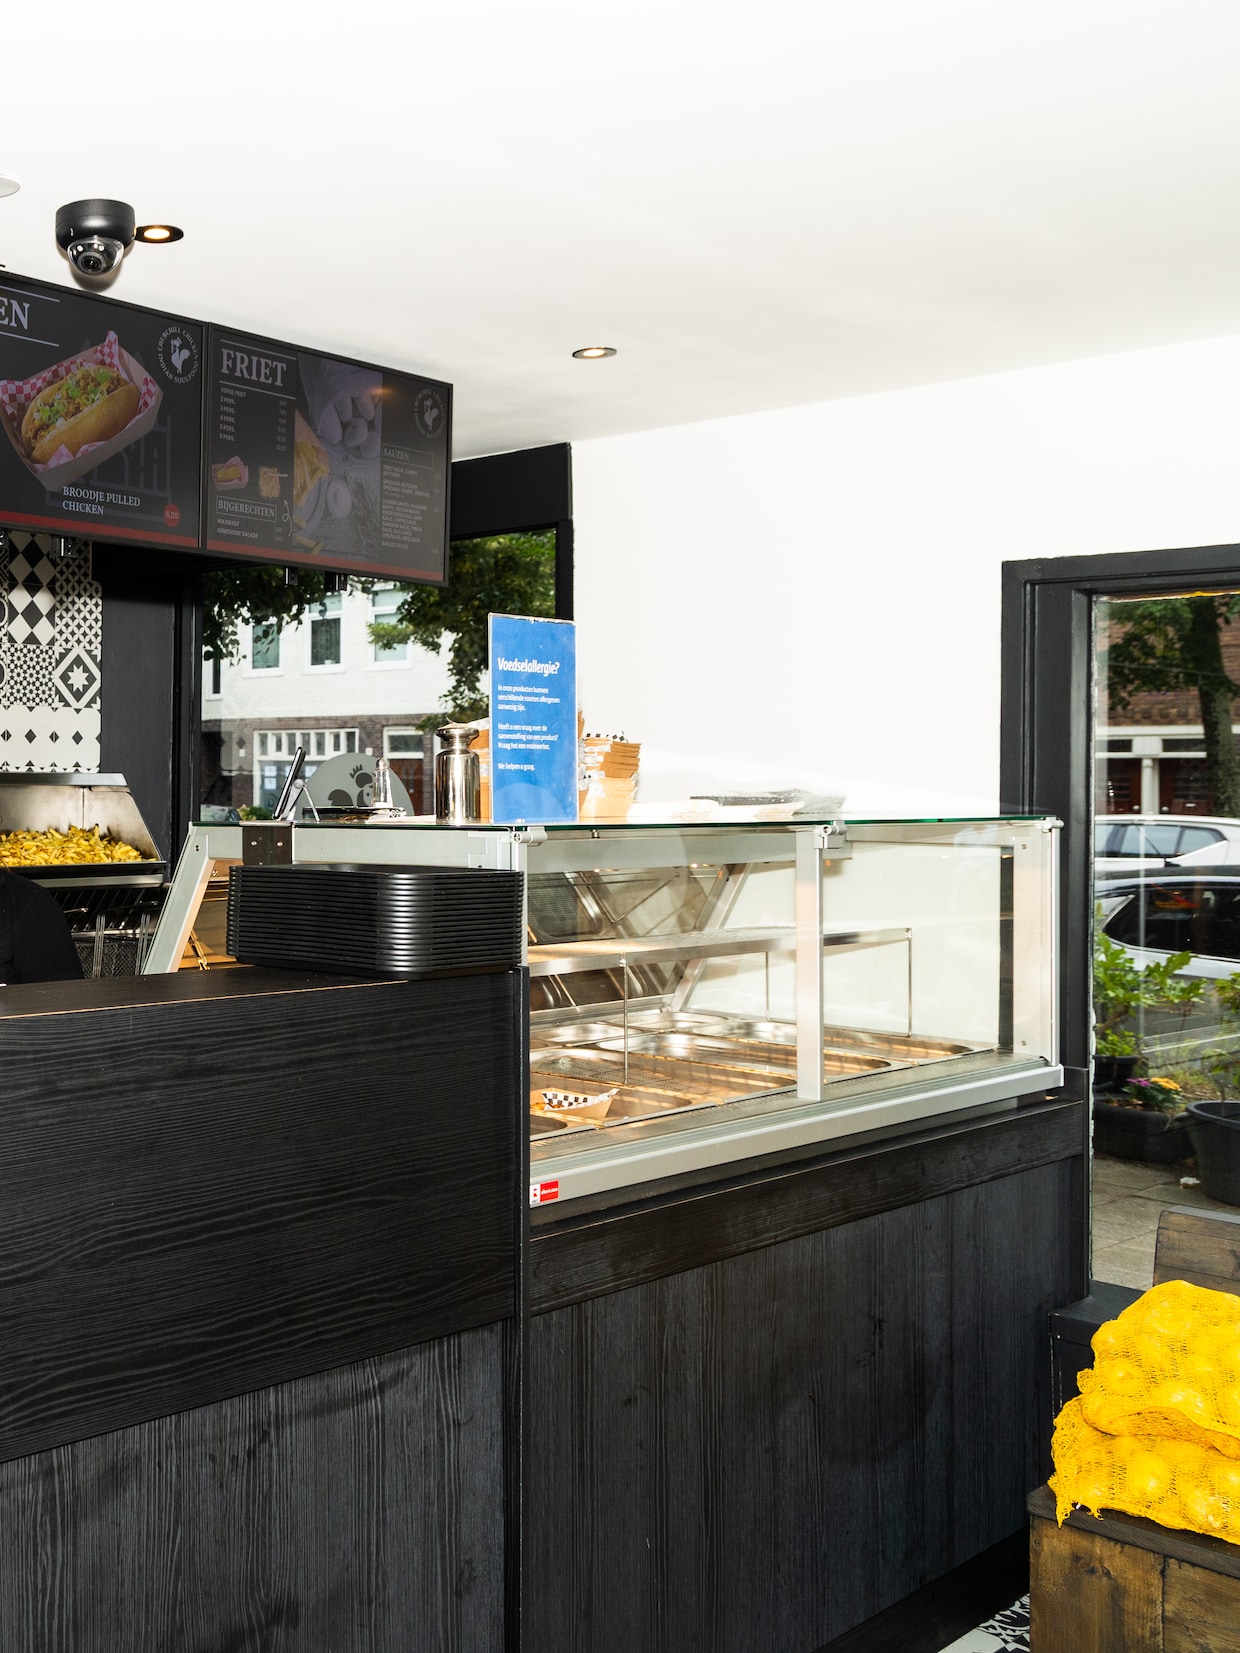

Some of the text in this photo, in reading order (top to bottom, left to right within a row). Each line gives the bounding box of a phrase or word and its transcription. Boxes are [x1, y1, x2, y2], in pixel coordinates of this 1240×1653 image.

[221, 348, 287, 387] FRIET
[63, 486, 141, 507] BROODJE PULLED
[63, 500, 104, 515] CHICKEN
[218, 499, 275, 518] BIJGERECHTEN
[497, 657, 560, 677] Voedselallergie?
